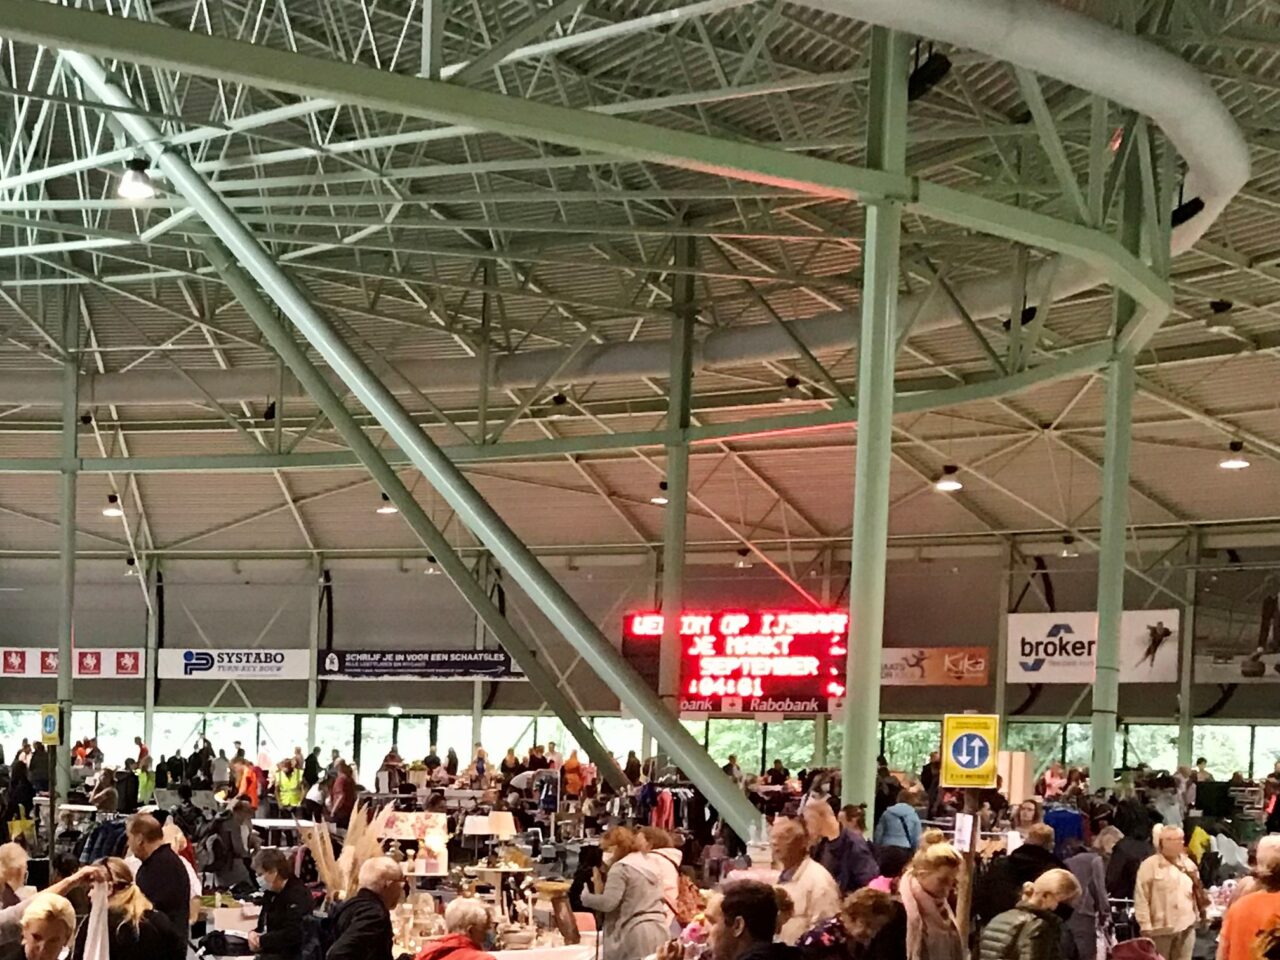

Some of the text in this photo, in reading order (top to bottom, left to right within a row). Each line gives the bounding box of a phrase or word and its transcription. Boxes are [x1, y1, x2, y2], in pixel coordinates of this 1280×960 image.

[725, 635, 794, 655] MARKT
[217, 652, 285, 664] SYSTABO
[406, 653, 429, 661] VOOR
[430, 653, 448, 661] EEN
[700, 656, 820, 676] SEPTEMBER
[750, 697, 819, 712] Rabobank
